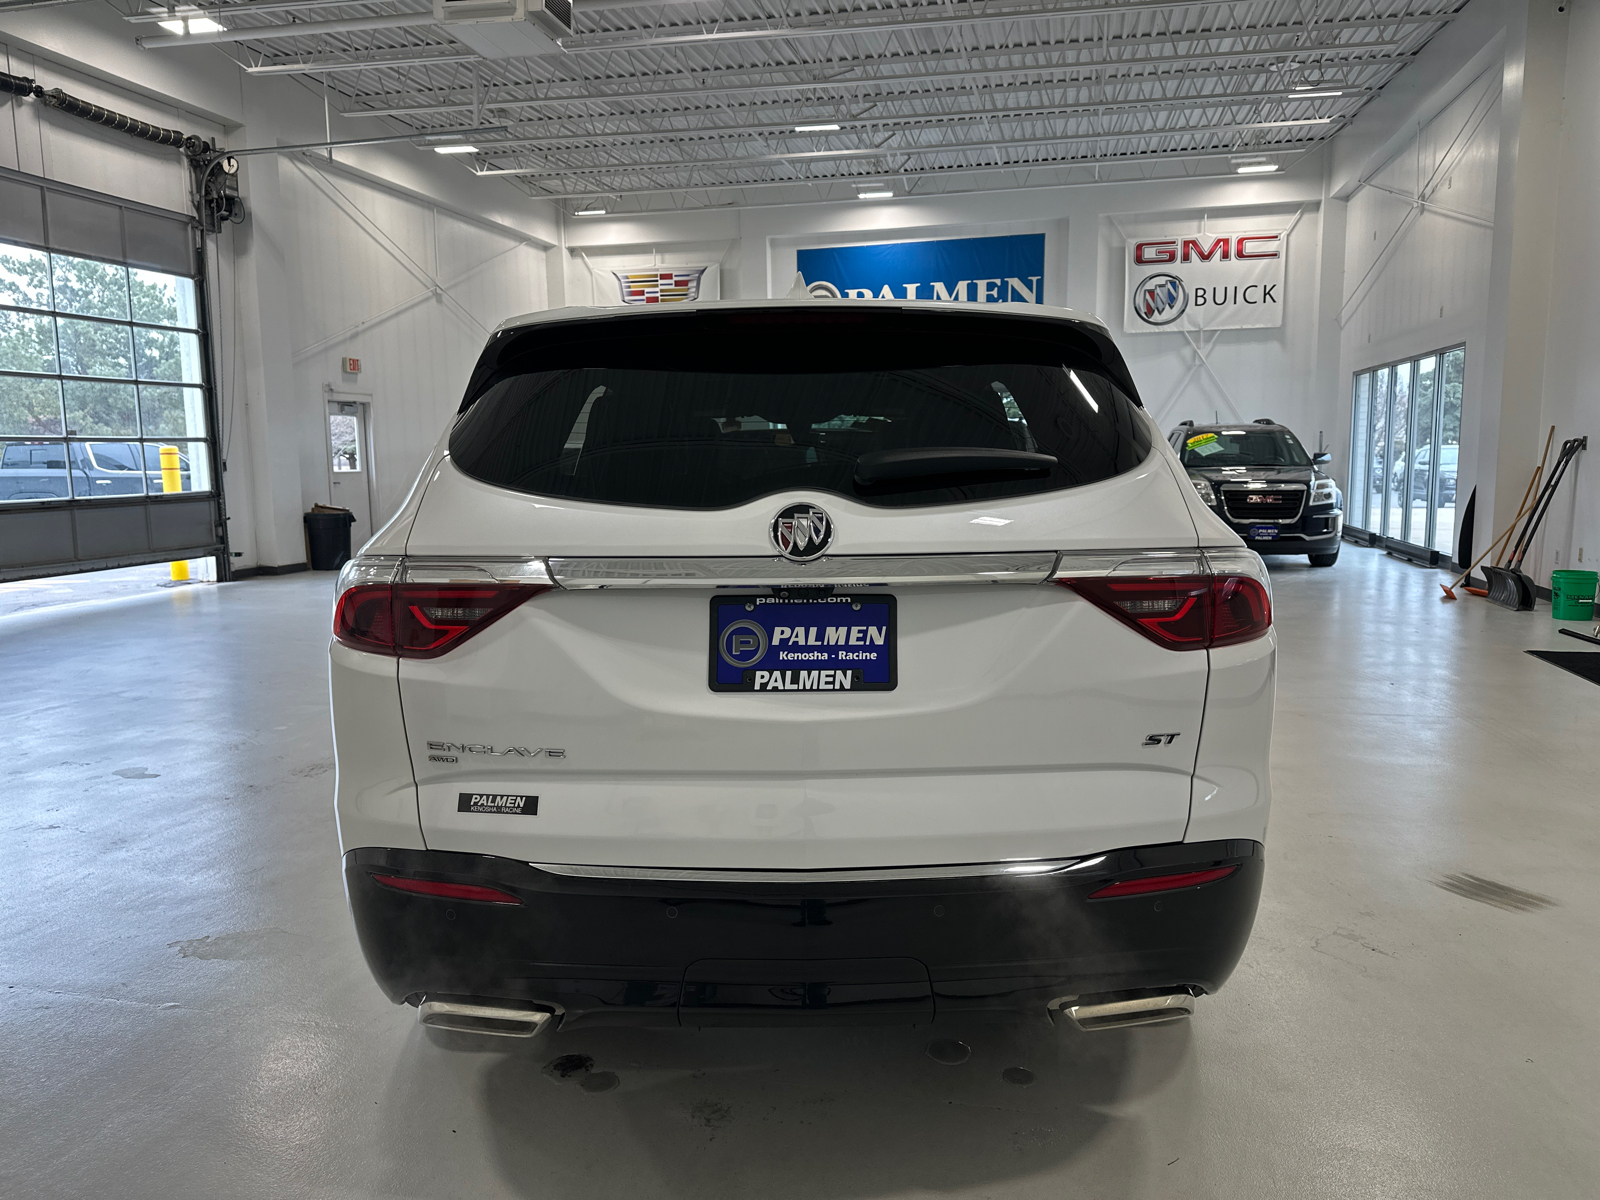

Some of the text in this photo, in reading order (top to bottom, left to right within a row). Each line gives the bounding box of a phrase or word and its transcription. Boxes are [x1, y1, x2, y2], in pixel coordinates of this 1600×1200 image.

[1134, 233, 1281, 266] GMC
[1194, 284, 1277, 306] BUICK
[348, 357, 360, 372] EXIT
[1247, 495, 1283, 503] GMC
[771, 626, 887, 646] PALMEN
[779, 651, 828, 660] Kenosha
[838, 651, 878, 660] Racine
[754, 670, 852, 690] PALMEN
[1141, 732, 1181, 746] ST
[426, 741, 566, 759] ENCLAVE
[428, 755, 458, 764] AWD
[470, 795, 526, 807] PALMEN
